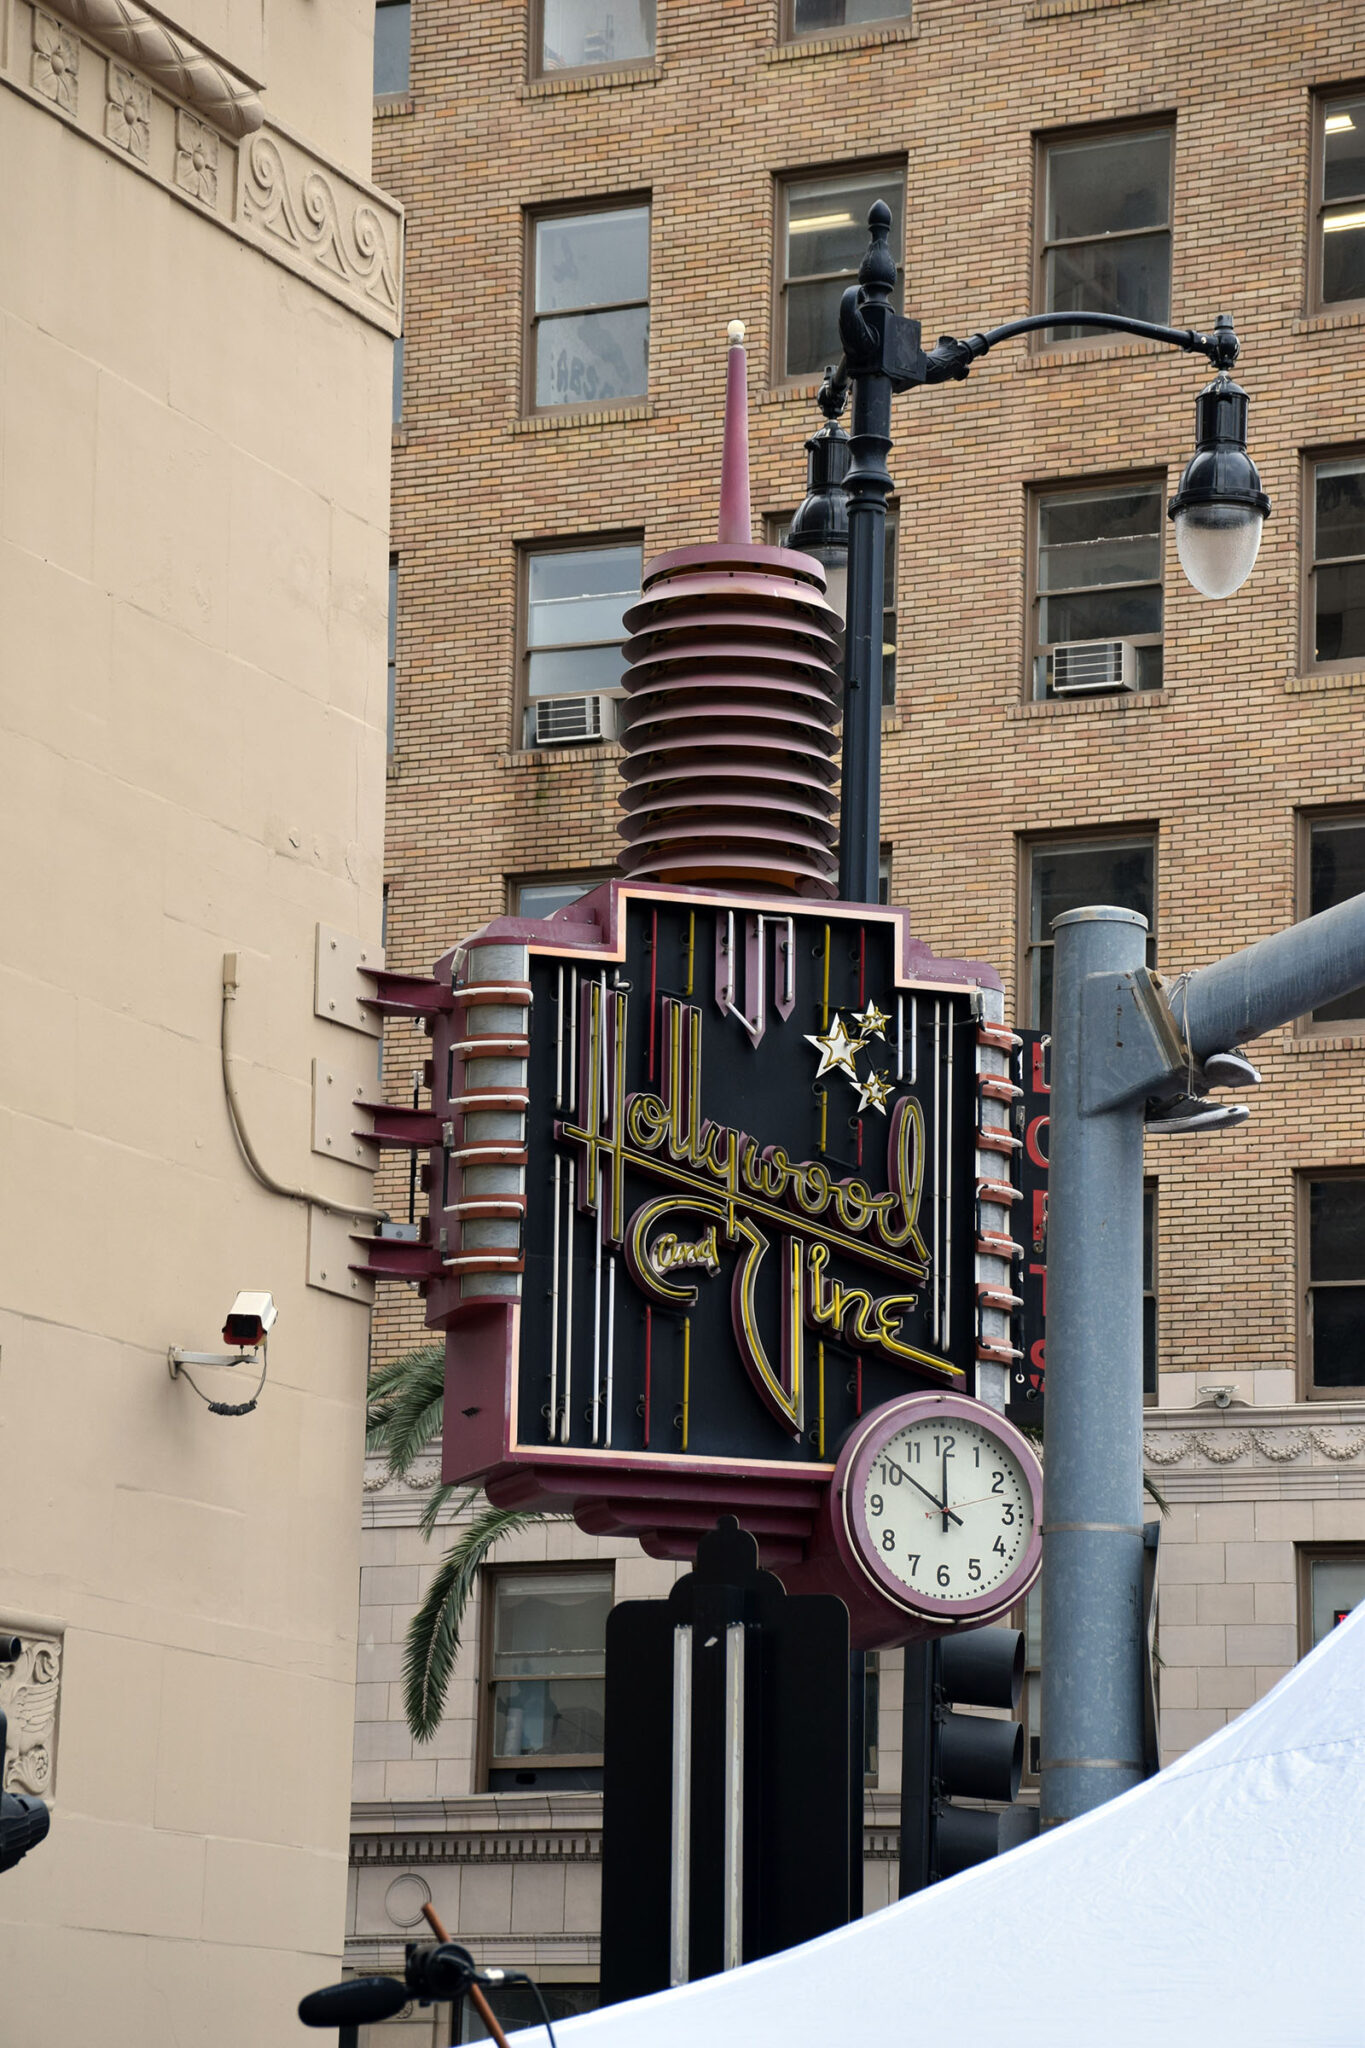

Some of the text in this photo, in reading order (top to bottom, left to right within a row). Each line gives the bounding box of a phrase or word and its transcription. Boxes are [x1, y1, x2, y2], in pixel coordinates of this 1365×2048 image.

[558, 979, 931, 1278] Hollywood
[905, 1441, 921, 1463] 11
[934, 1435, 955, 1458] 12
[972, 1446, 980, 1468] 1
[880, 1464, 903, 1486] 10
[991, 1471, 1004, 1494] 2
[870, 1494, 884, 1516] 9
[1001, 1503, 1015, 1525] 3
[882, 1529, 896, 1551] 8
[992, 1535, 1006, 1557] 4
[908, 1554, 921, 1576] 7
[937, 1564, 950, 1587] 6
[968, 1558, 982, 1580] 5
